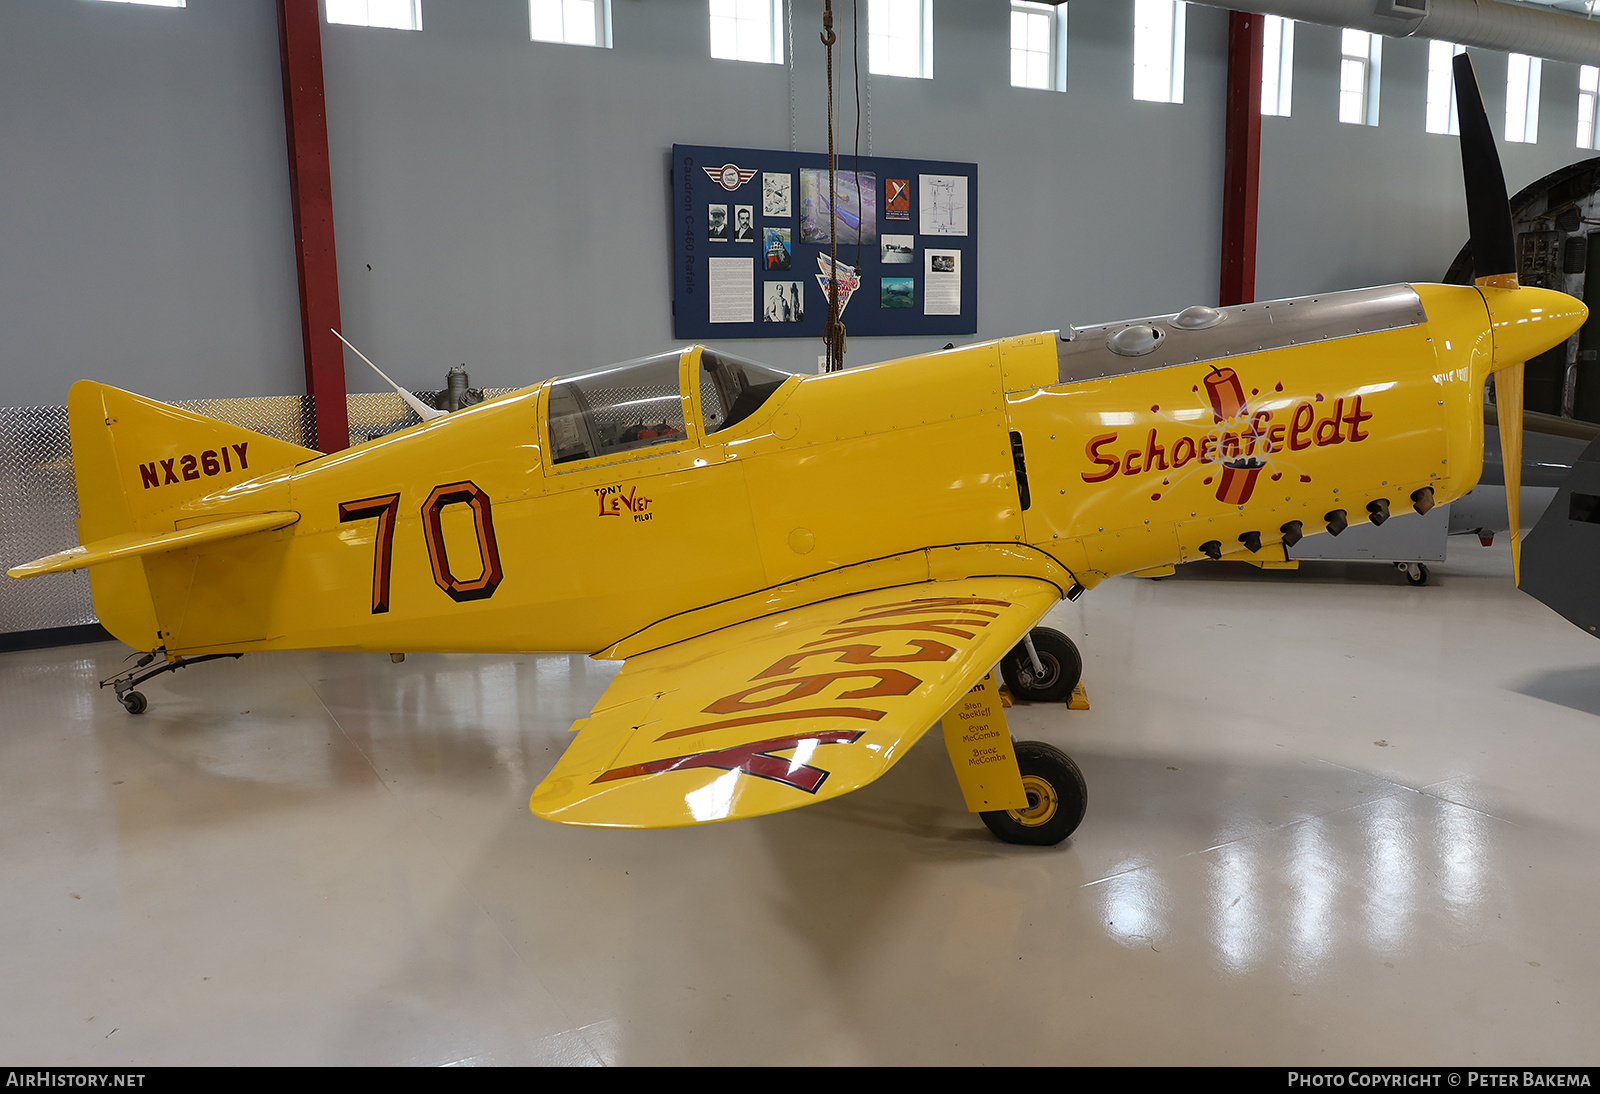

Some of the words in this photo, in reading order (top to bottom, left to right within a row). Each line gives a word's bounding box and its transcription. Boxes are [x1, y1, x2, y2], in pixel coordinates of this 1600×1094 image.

[684, 157, 694, 211] Caudron
[685, 216, 694, 251] C-460
[686, 256, 695, 294] Rafale
[1081, 394, 1373, 483] Schoenfeldt
[139, 442, 249, 489] NX261Y
[594, 484, 622, 496] TONY
[634, 512, 653, 522] PILOT
[338, 480, 504, 614] 70
[964, 702, 982, 710] Stan
[968, 724, 989, 732] Evan
[962, 731, 1000, 743] McCombs
[973, 747, 997, 757] Bruce
[968, 754, 1007, 766] McCombs
